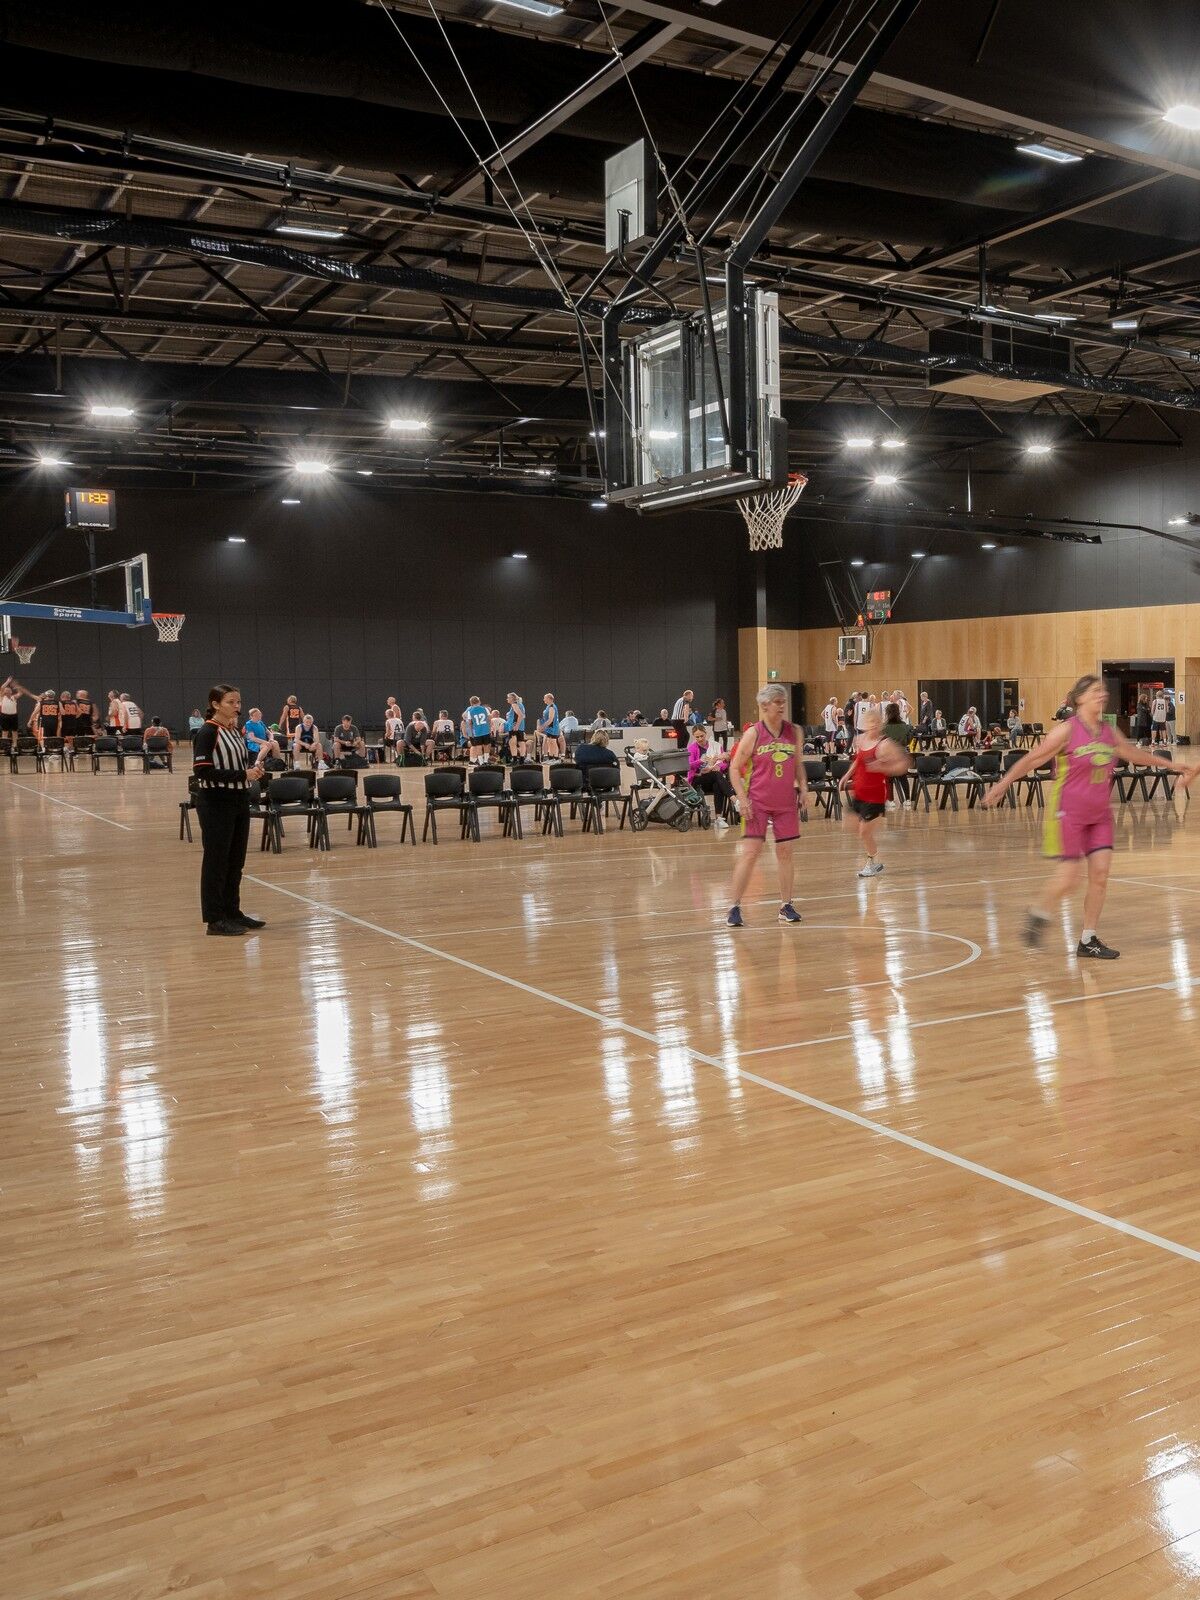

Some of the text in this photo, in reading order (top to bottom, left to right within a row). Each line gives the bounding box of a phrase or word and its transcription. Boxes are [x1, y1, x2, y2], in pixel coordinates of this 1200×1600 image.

[1179, 694, 1184, 702] 5
[474, 713, 487, 725] 12
[775, 763, 784, 778] 8
